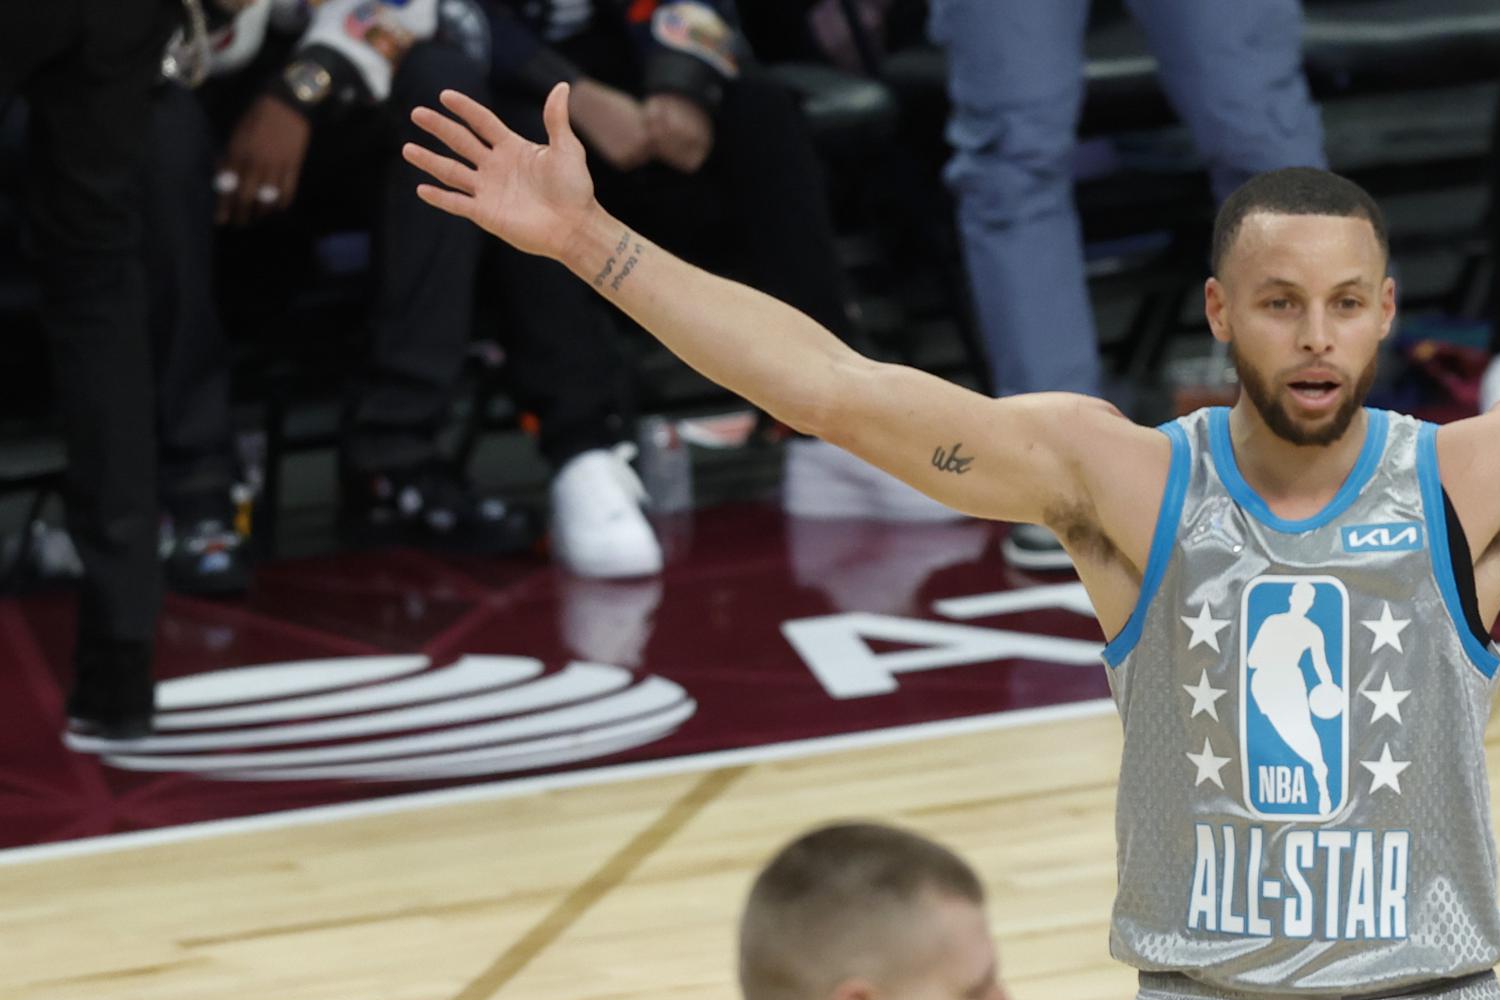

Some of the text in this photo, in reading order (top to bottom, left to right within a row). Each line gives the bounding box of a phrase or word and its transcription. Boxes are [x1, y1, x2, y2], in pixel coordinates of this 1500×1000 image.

[1348, 526, 1417, 548] KIA
[1258, 764, 1308, 804] NBA
[1187, 823, 1410, 940] ALL-STAR
